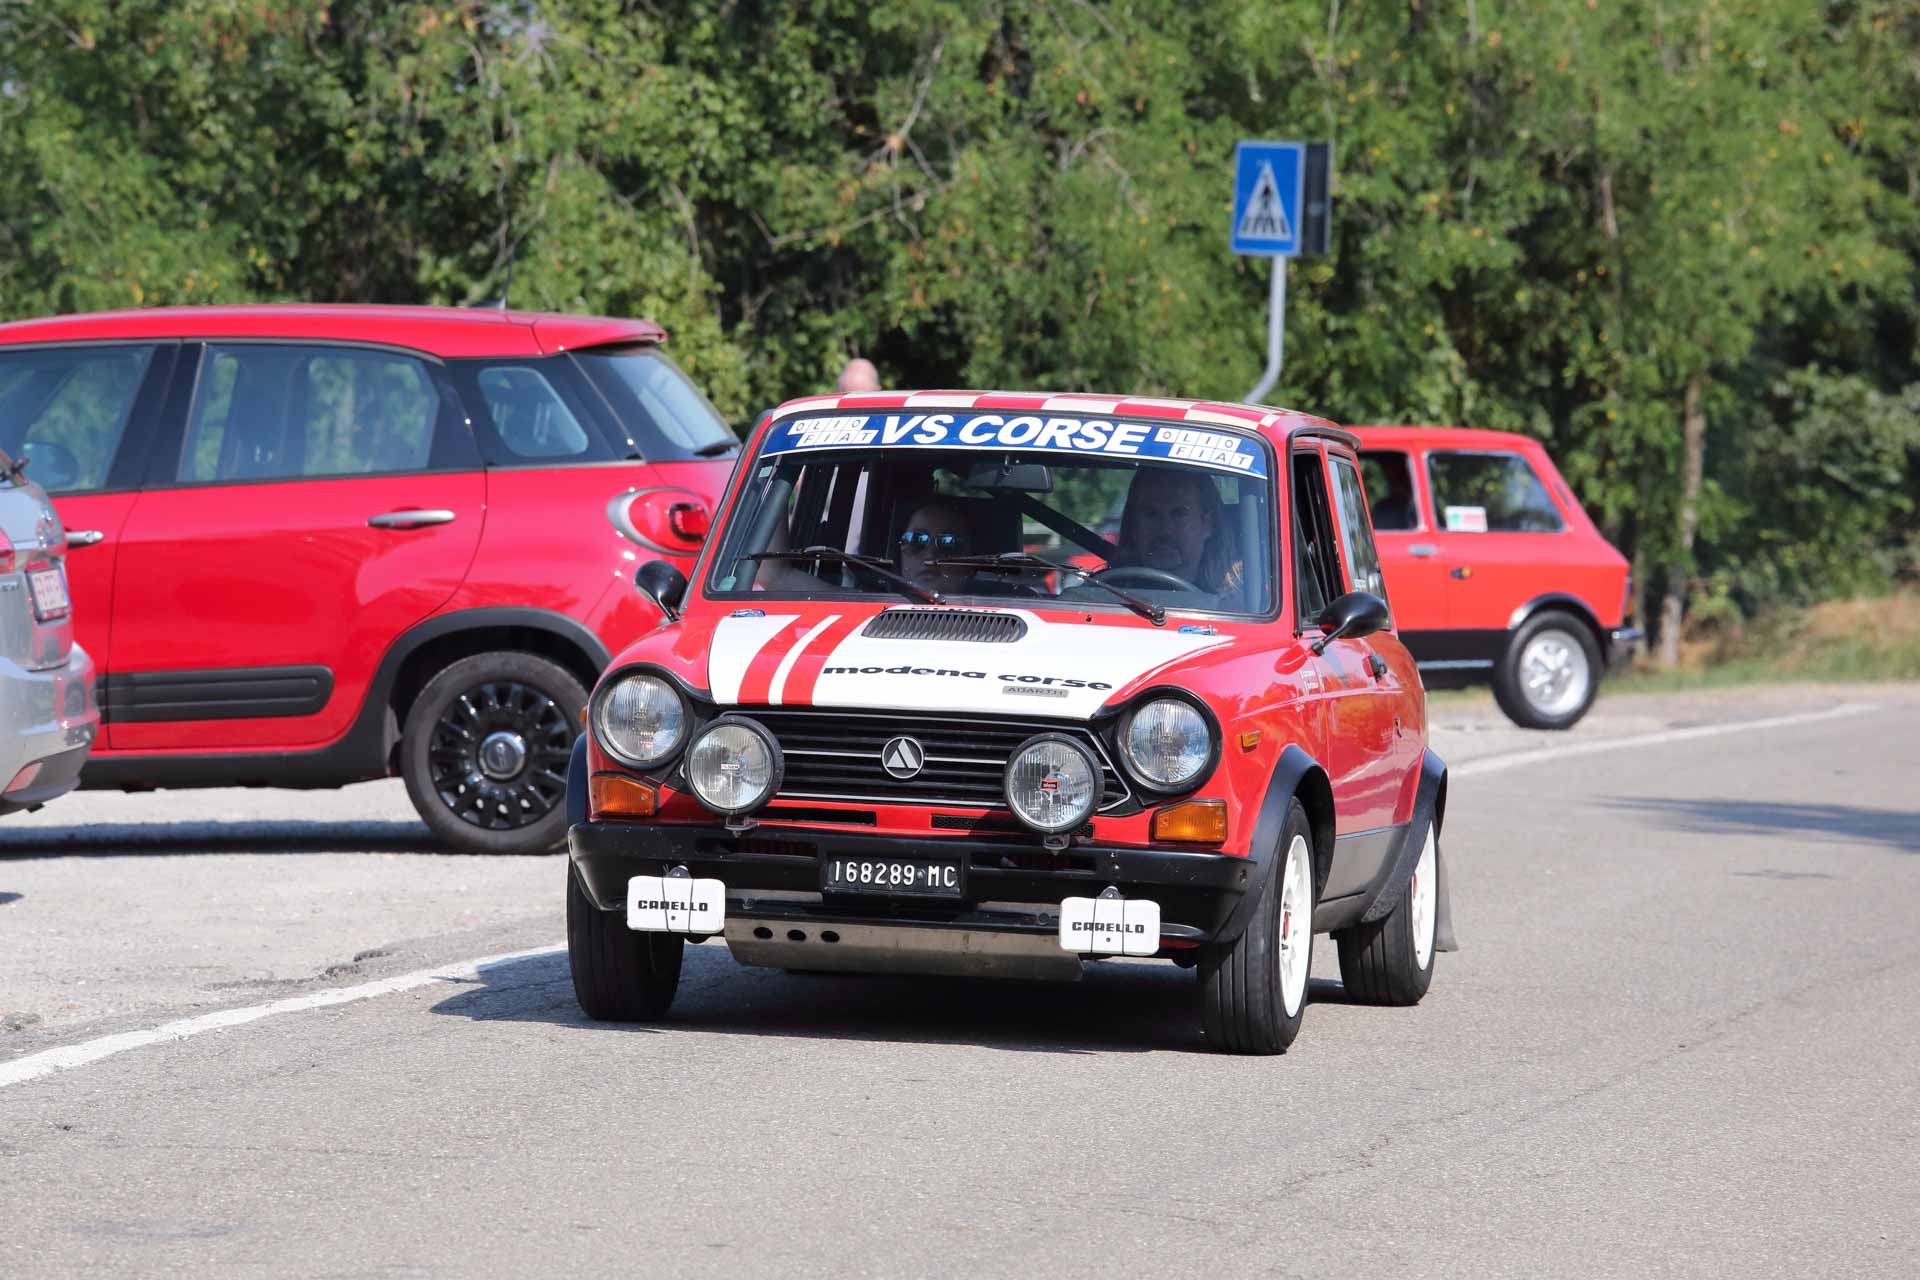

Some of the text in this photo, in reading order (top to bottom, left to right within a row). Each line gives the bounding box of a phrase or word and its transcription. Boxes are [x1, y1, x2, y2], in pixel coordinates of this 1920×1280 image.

[795, 419, 862, 432] OLIO
[881, 414, 1152, 453] VS CORSE
[803, 432, 873, 445] FIAT
[1162, 429, 1234, 449] OLIO
[1175, 446, 1248, 465] FIAT
[823, 665, 1113, 690] modena corse
[835, 861, 955, 887] 168289 MC
[637, 899, 709, 912] CARELLO
[1071, 921, 1145, 934] CARELLO
